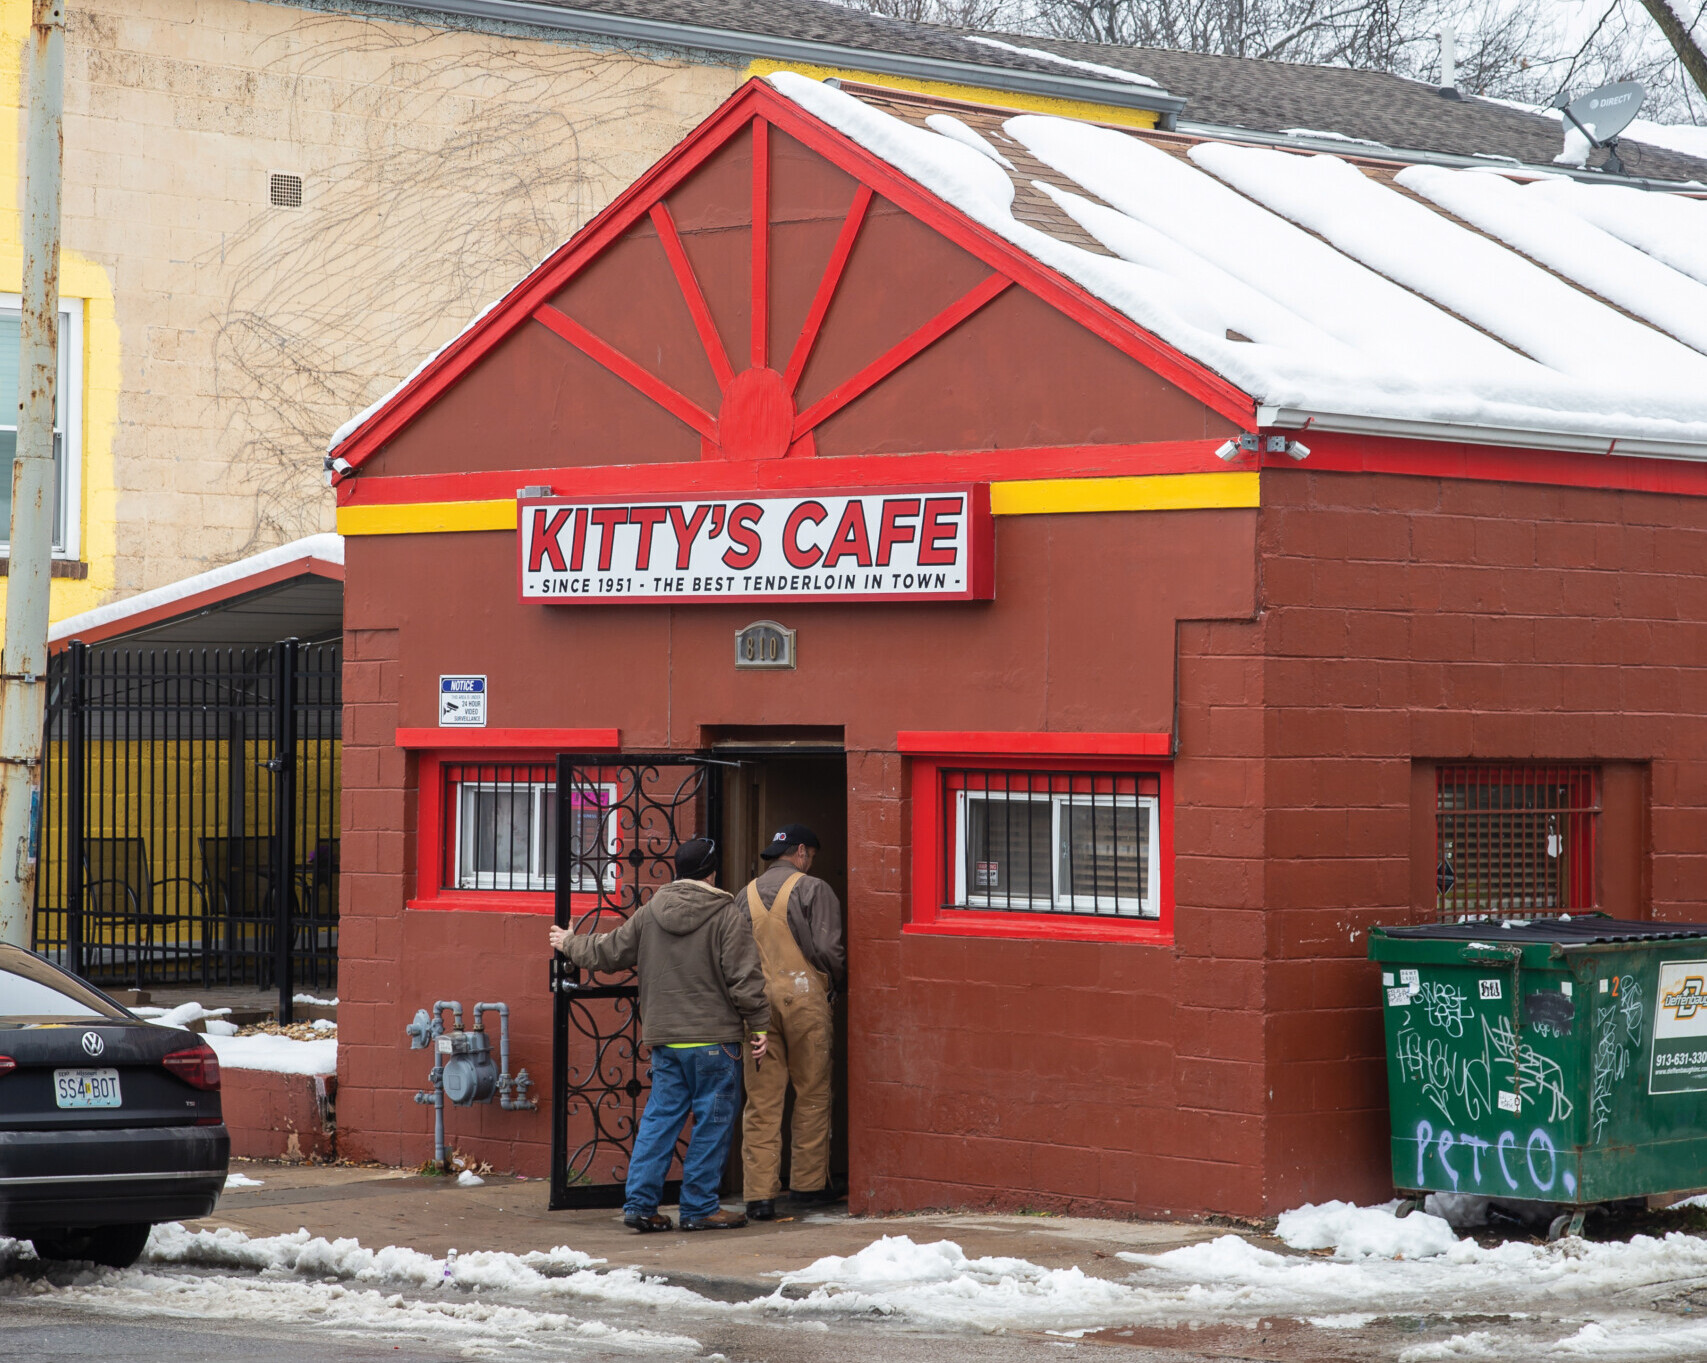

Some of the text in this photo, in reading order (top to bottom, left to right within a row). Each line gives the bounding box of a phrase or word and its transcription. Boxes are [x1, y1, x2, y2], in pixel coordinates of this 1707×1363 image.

[1600, 93, 1633, 108] DIRECTV
[528, 497, 964, 572] KITTY'S CAFE
[542, 573, 946, 593] SINCE 1951 THE BEST TENDERLOIN IN TOWN
[746, 637, 777, 660] 810
[451, 680, 475, 691] NOTICE
[1612, 976, 1620, 997] 2
[1656, 1051, 1707, 1067] 913-631-330
[59, 1077, 116, 1098] SS4 BOT
